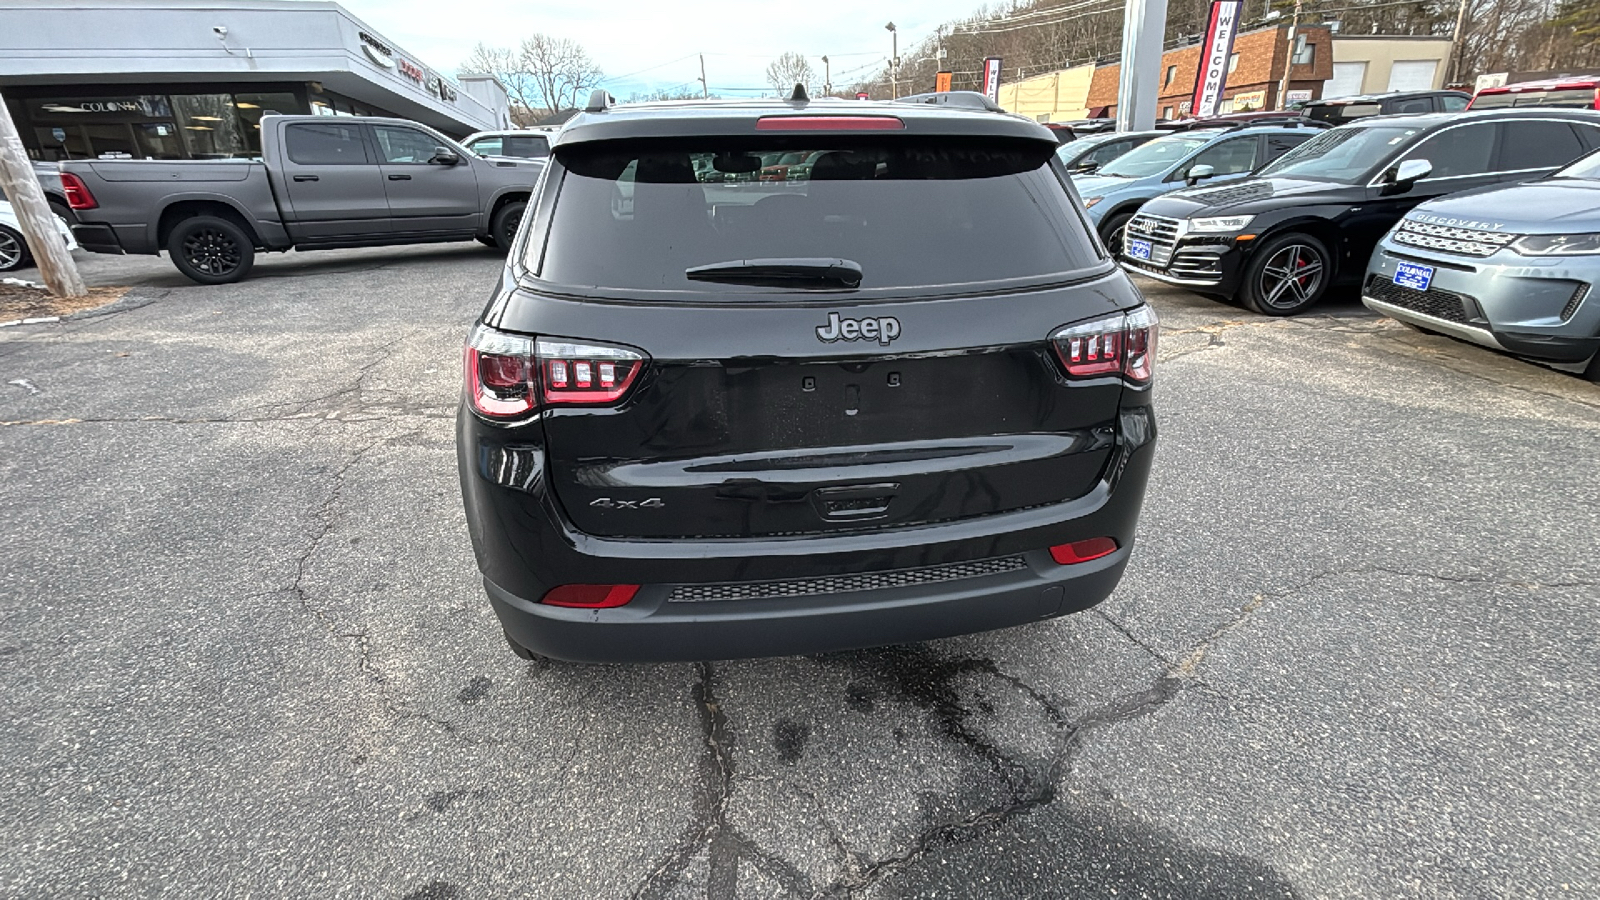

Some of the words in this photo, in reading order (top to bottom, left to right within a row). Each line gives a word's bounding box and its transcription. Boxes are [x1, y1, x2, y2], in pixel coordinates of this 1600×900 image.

[1205, 16, 1231, 103] WELCOME
[989, 69, 997, 99] WELC
[1416, 214, 1504, 230] DISCOVERY
[816, 312, 900, 345] Jeep
[589, 497, 666, 509] 4x4
